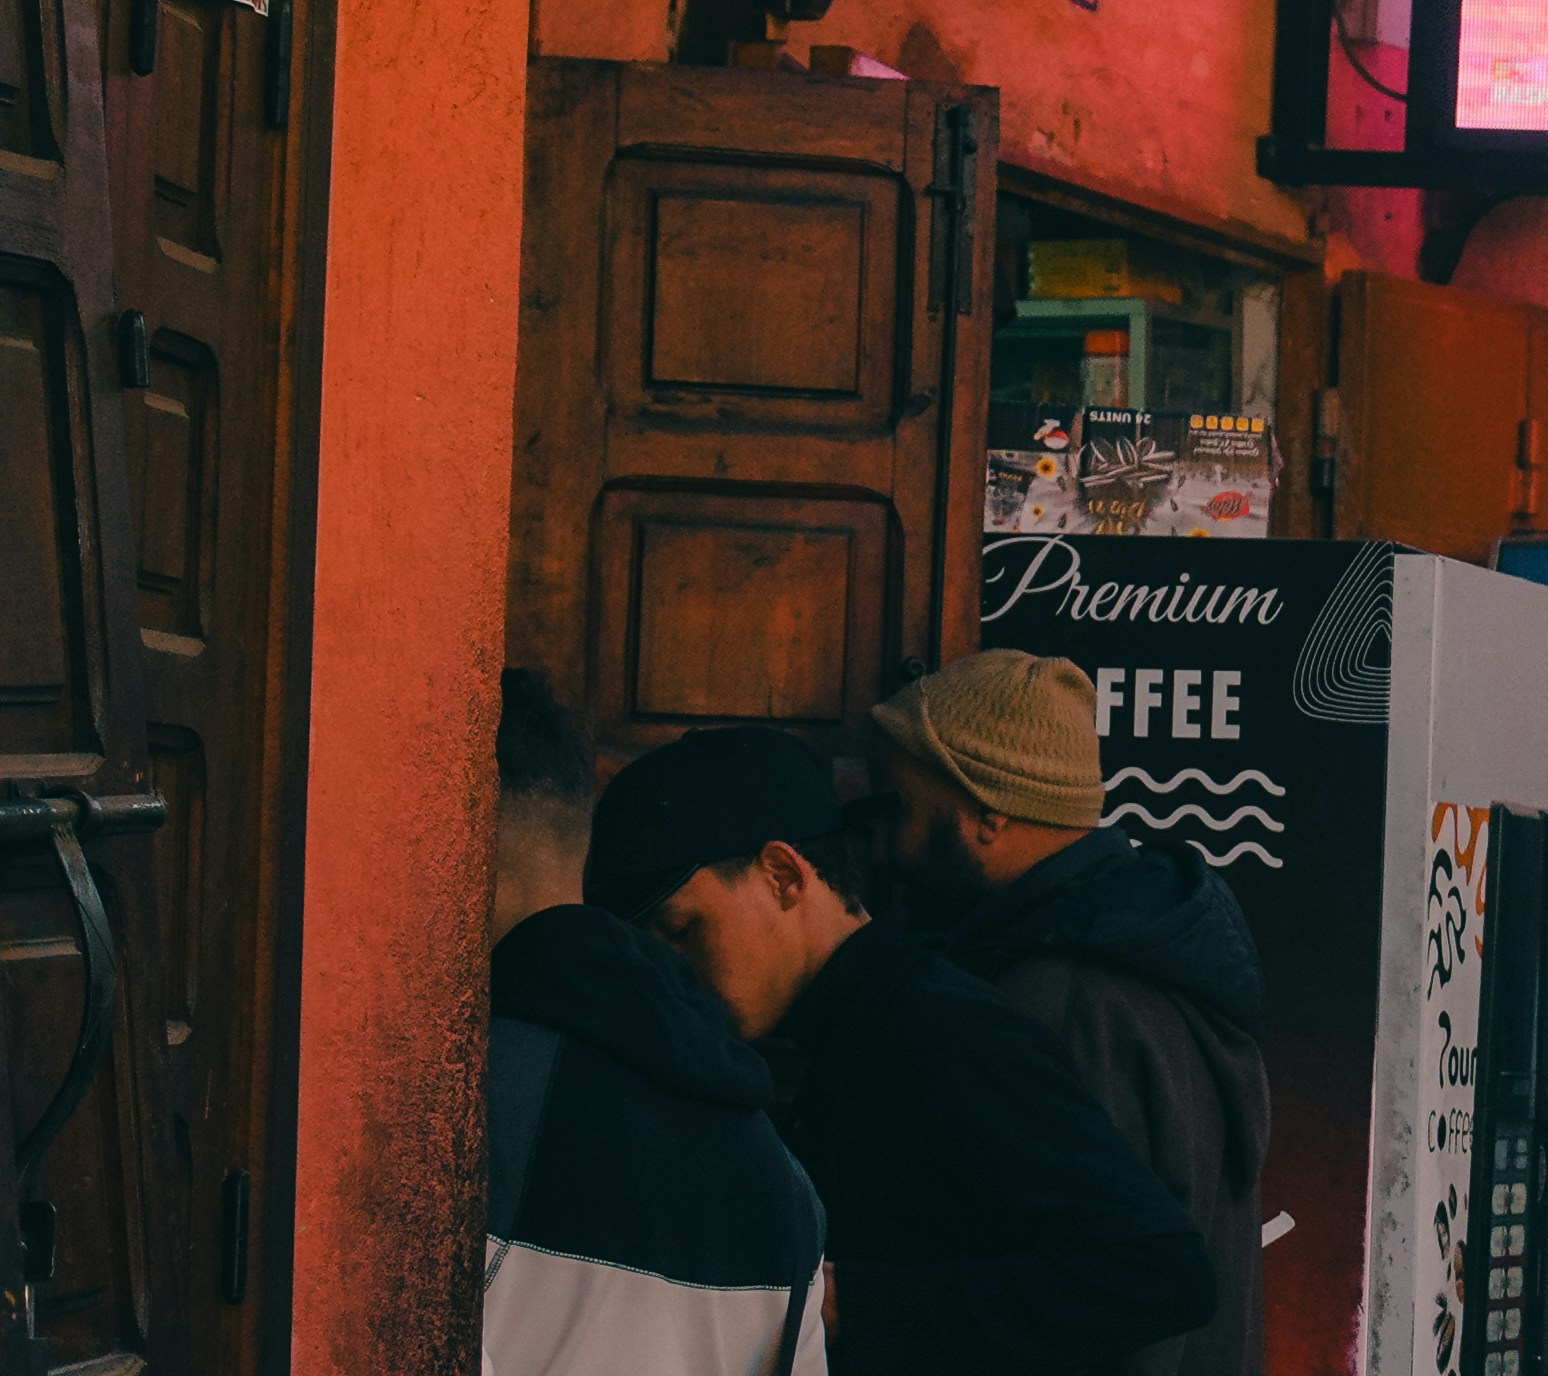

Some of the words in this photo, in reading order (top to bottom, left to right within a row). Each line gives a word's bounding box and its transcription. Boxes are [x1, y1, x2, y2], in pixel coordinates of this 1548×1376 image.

[1089, 409, 1132, 424] UNITS
[981, 533, 1284, 625] Premium
[1096, 667, 1241, 739] FFEE
